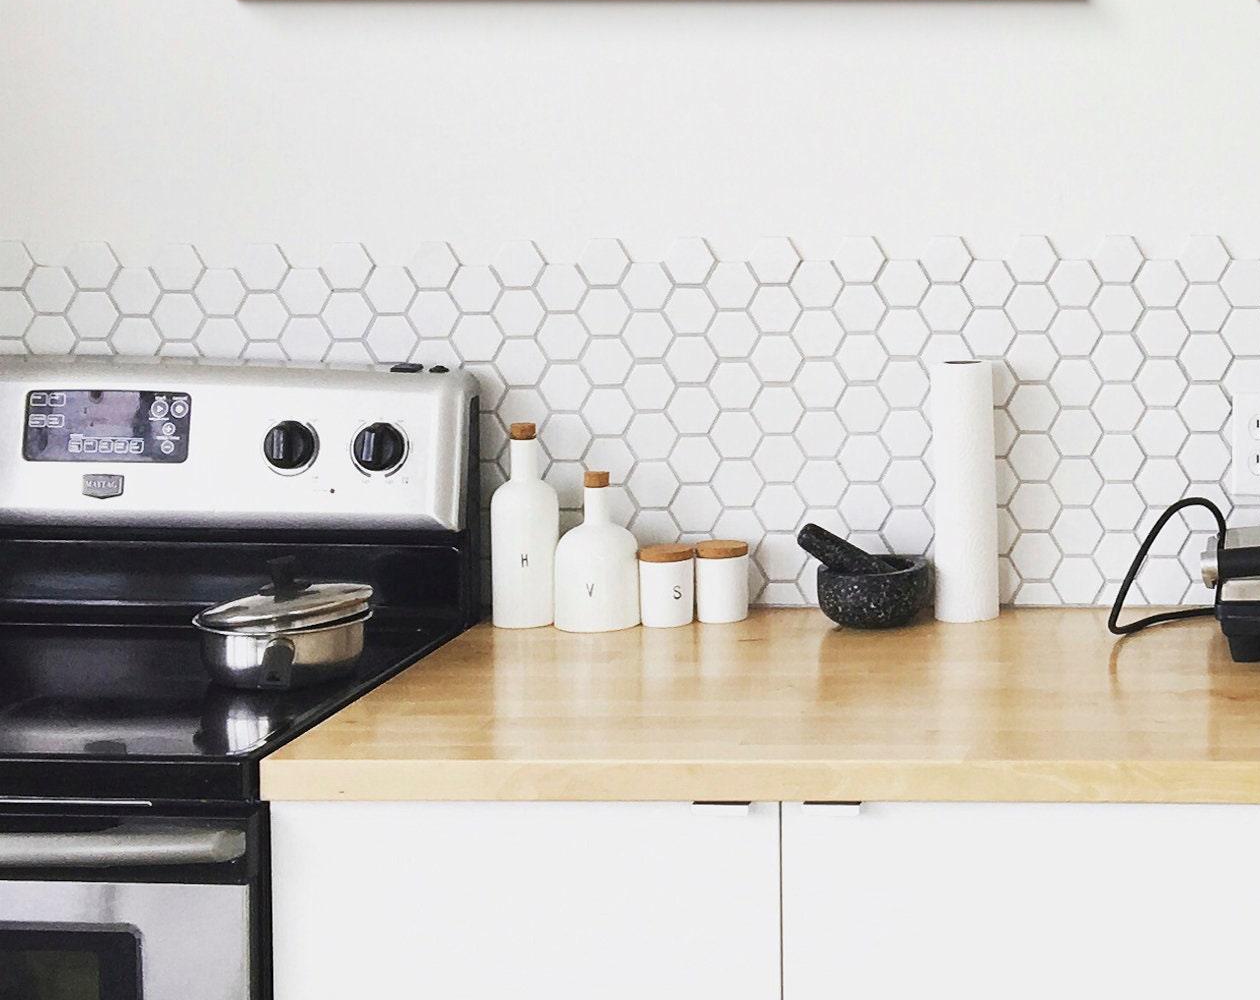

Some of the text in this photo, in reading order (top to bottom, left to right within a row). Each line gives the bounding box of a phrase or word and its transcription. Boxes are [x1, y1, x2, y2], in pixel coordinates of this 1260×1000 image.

[85, 480, 118, 489] MAYTAG
[521, 554, 529, 568] H
[586, 584, 595, 597] V
[673, 585, 682, 600] S
